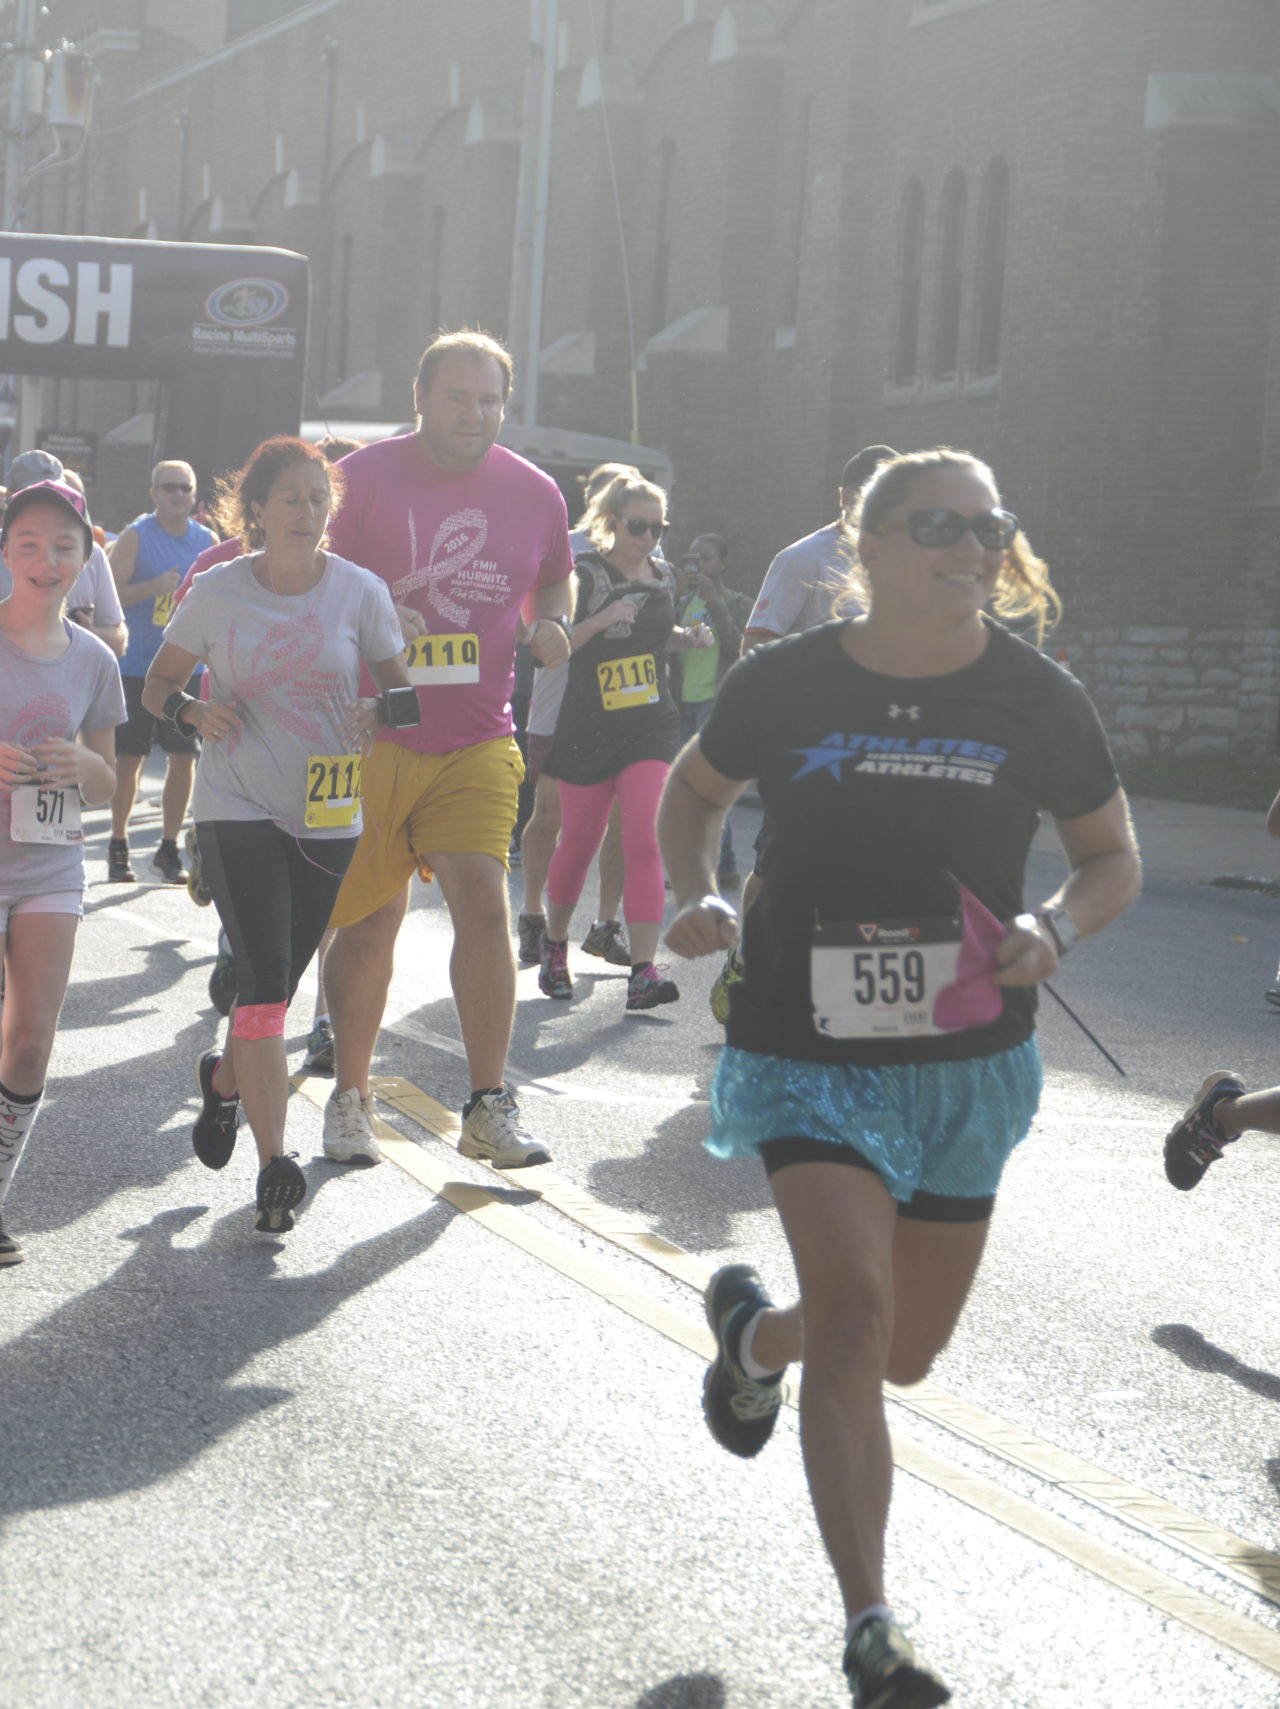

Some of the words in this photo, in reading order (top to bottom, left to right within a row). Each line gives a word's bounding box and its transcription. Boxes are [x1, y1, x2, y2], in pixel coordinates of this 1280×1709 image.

[192, 327, 231, 341] Racine
[233, 330, 295, 346] MultiSports
[443, 532, 469, 553] 2016
[457, 570, 508, 586] HURWITZ
[472, 559, 497, 571] FMH
[600, 658, 655, 693] 2116
[821, 732, 1008, 764] ATHLETES
[865, 752, 946, 763] SERVING
[308, 761, 361, 802] 211
[854, 760, 994, 786] ATHLETES
[36, 790, 65, 824] 571
[854, 950, 925, 1005] 559
